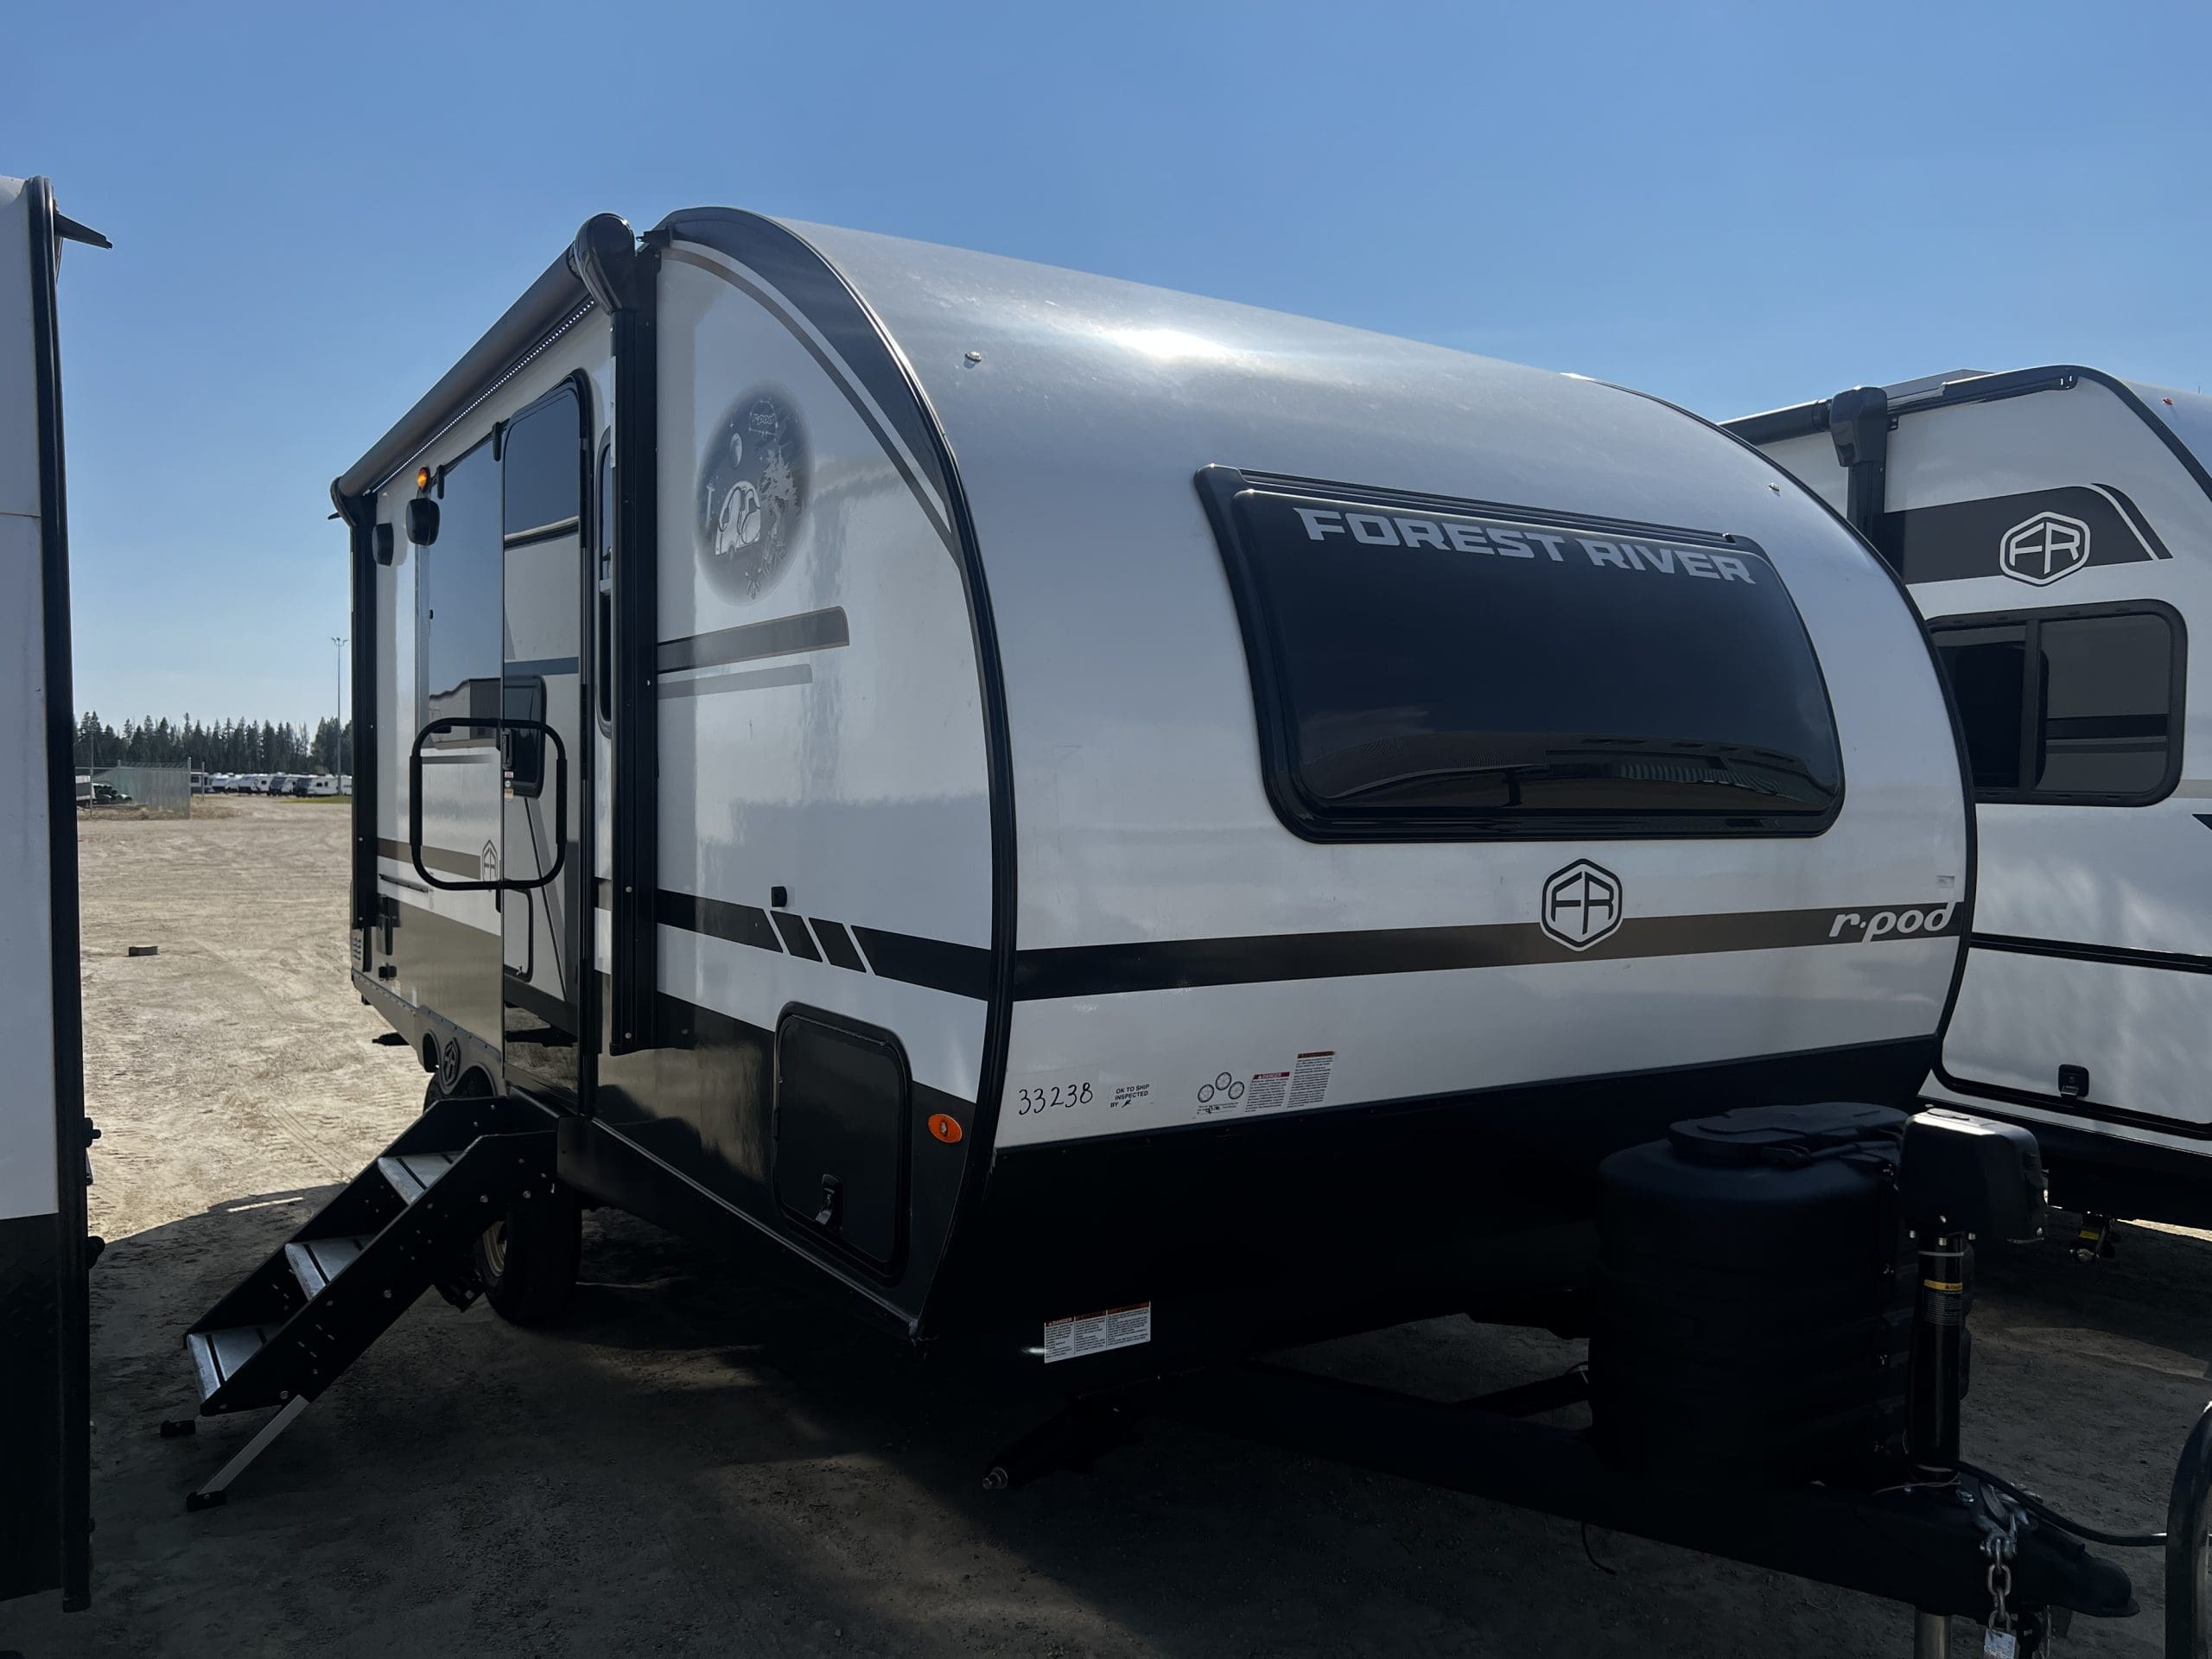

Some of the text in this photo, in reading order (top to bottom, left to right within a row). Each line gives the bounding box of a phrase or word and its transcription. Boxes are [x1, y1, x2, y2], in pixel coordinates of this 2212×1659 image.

[1293, 507, 1756, 585] FOREST RIVER
[1018, 1082, 1094, 1116] 33238
[1115, 1090, 1149, 1101] INSPECTED
